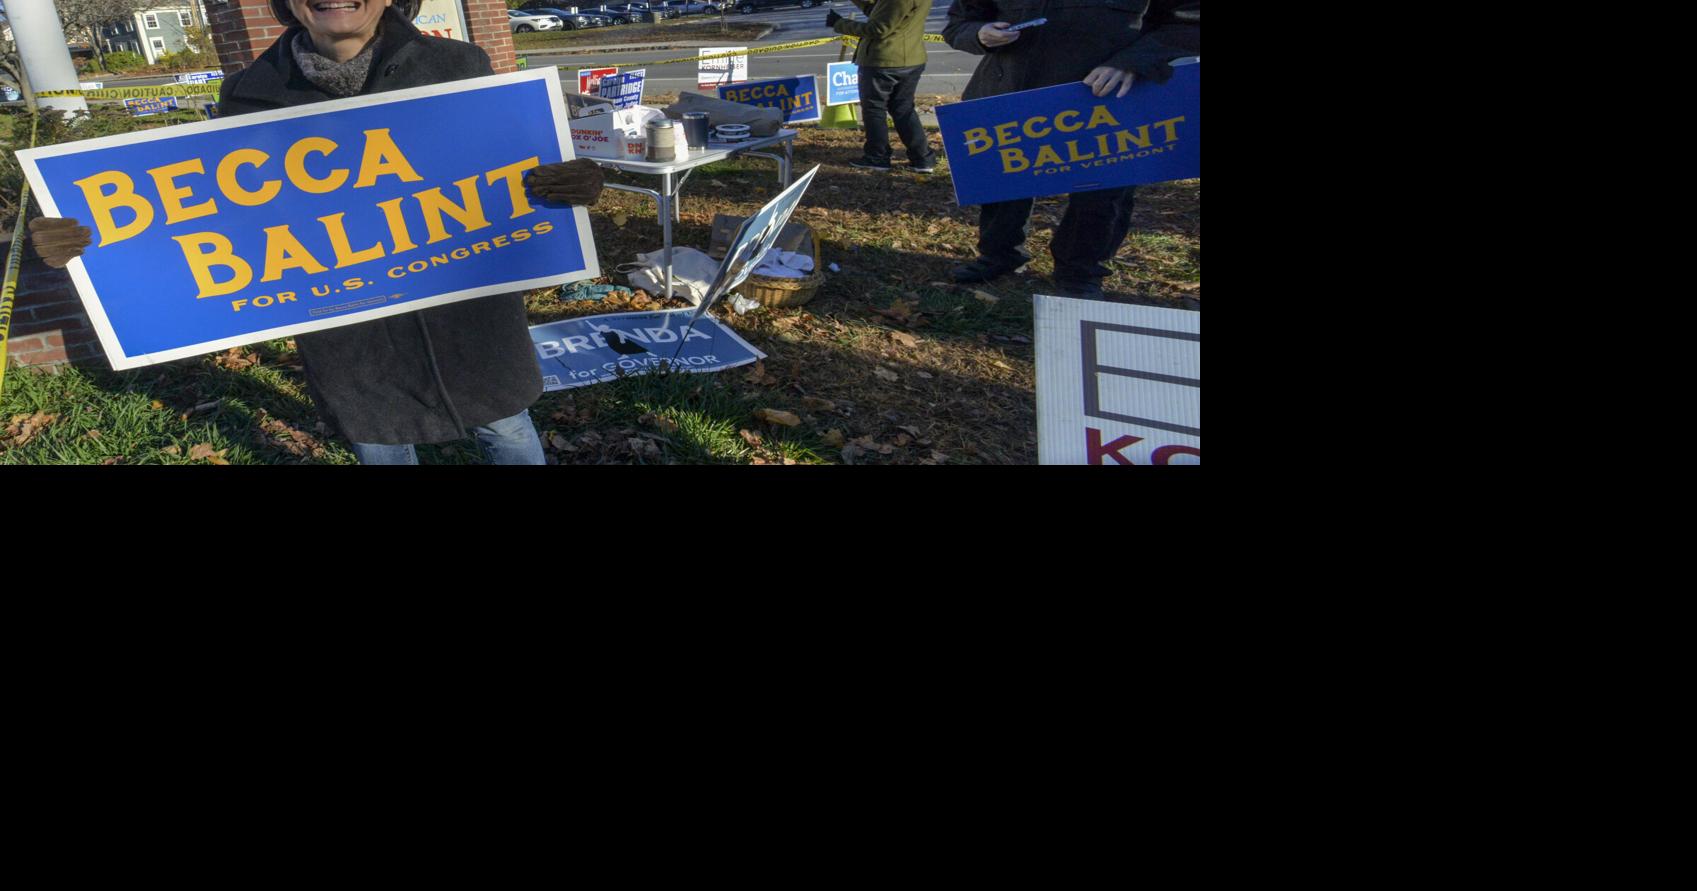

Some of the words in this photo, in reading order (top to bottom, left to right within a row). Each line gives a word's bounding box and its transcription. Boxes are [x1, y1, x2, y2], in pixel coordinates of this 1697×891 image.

[725, 84, 789, 103] BECCA
[964, 104, 1120, 155] BECCA
[1000, 116, 1185, 173] BALINT
[1033, 165, 1071, 176] FOR
[1081, 143, 1176, 169] VERMONT
[74, 127, 424, 247] BECCA
[173, 156, 540, 299] BALINT
[232, 292, 298, 312] FOR
[316, 276, 374, 298] U.S.
[387, 221, 554, 279] CONGRESS
[537, 325, 712, 361] BRENDA
[568, 367, 598, 381] for
